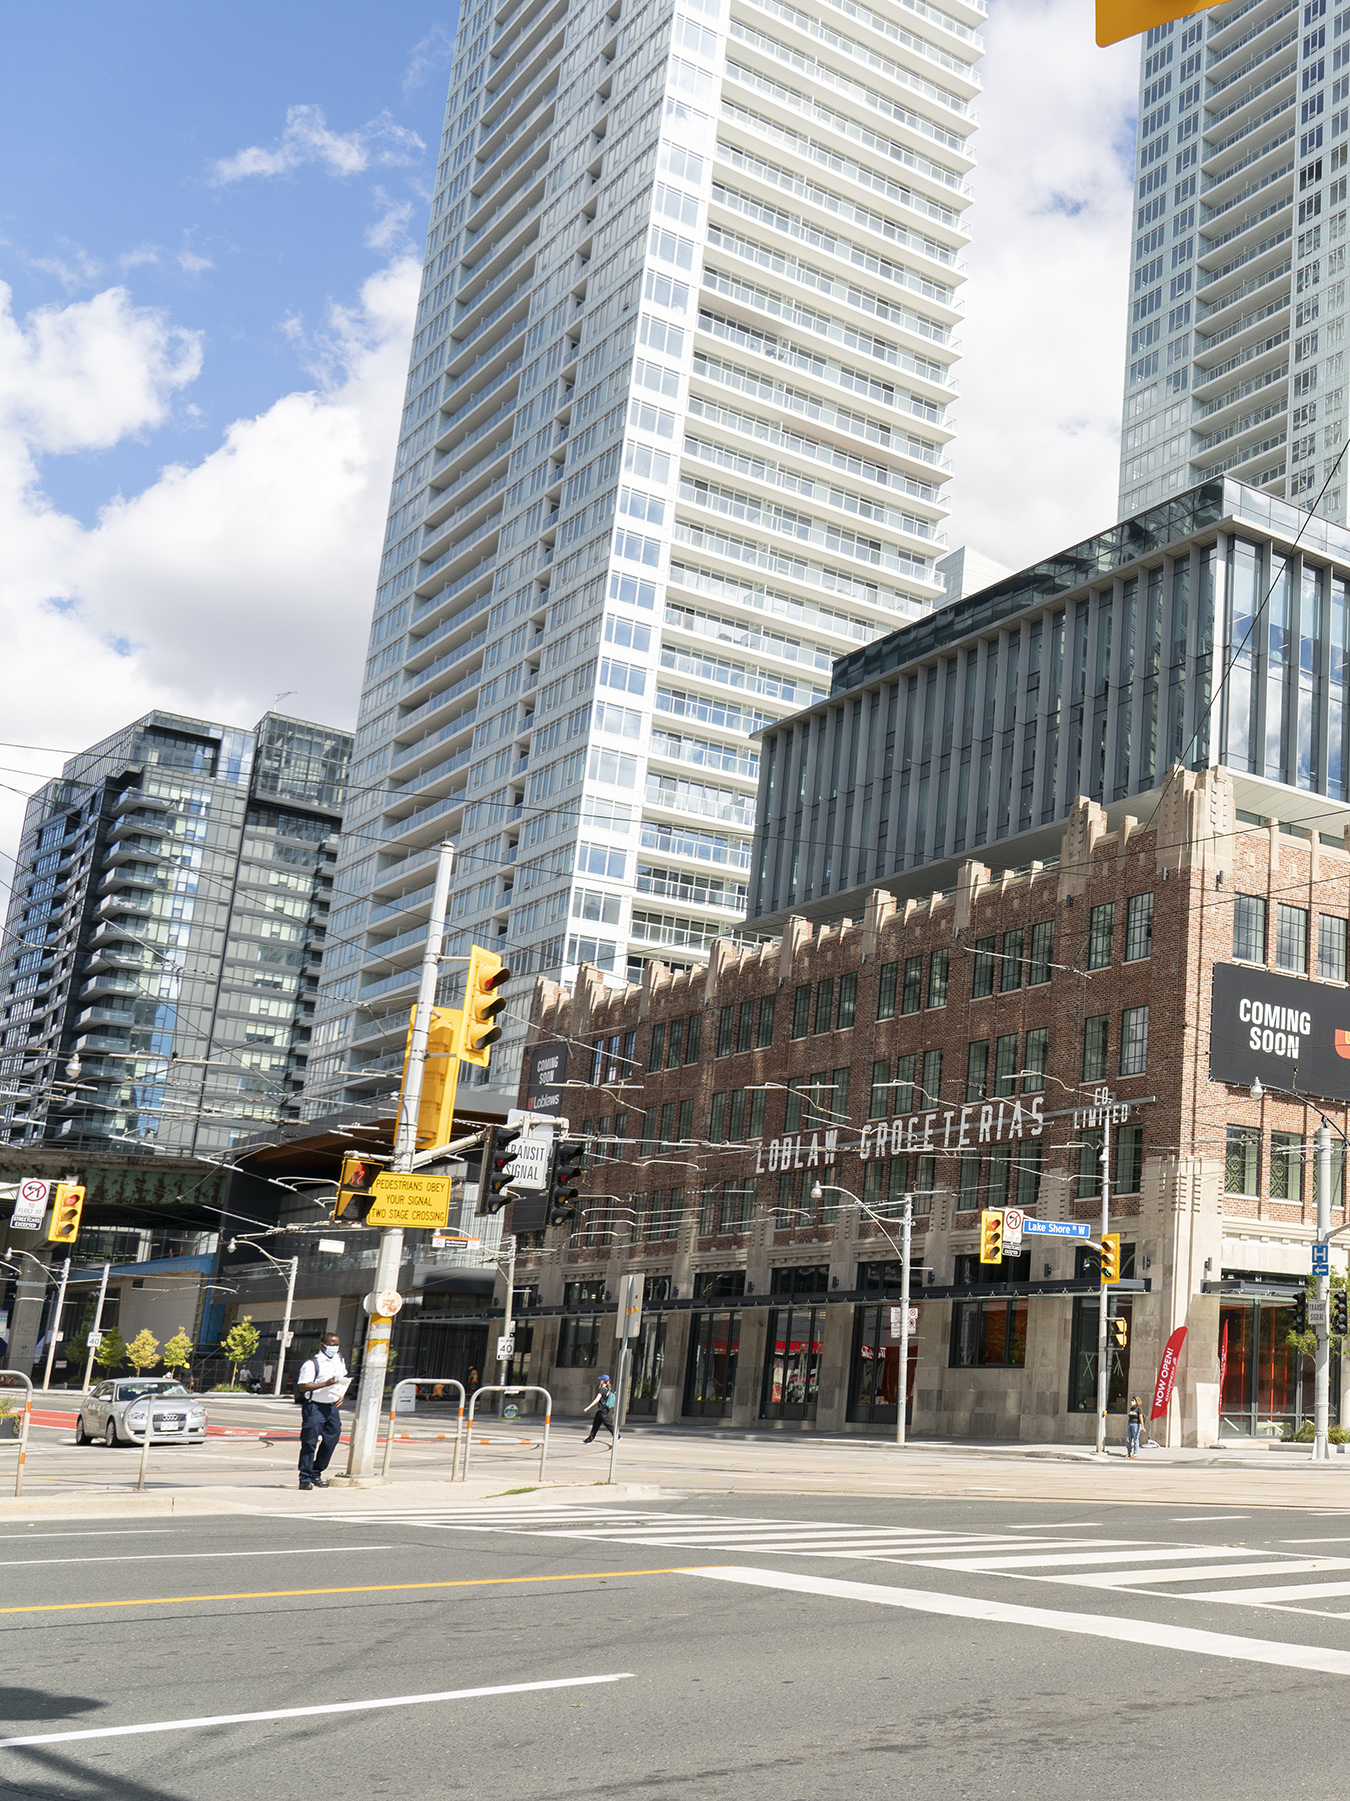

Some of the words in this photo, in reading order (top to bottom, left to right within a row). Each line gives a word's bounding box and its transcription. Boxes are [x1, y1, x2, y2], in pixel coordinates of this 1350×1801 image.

[1240, 998, 1311, 1035] COMING
[1250, 1026, 1300, 1060] SOON
[533, 1094, 559, 1109] Loblaws
[1095, 1086, 1112, 1106] CO.
[1074, 1104, 1128, 1128] LIMITED
[756, 1130, 838, 1174] LOBLAW
[860, 1096, 1044, 1160] GROCETERIAS
[376, 1179, 423, 1191] PEDESTRIANS
[427, 1182, 445, 1192] OBEY
[386, 1195, 405, 1204] YOUR
[408, 1196, 432, 1206] SIGNAL
[372, 1208, 386, 1218] TWO
[389, 1209, 409, 1219] STAGE
[412, 1211, 444, 1221] CROSSING
[1028, 1222, 1046, 1232] Lake
[1048, 1224, 1070, 1234] Shore
[1078, 1227, 1085, 1235] W
[1314, 1248, 1326, 1261] H
[500, 1345, 512, 1353] 40
[1155, 1379, 1166, 1406] NOW
[1161, 1347, 1173, 1378] OPEN!
